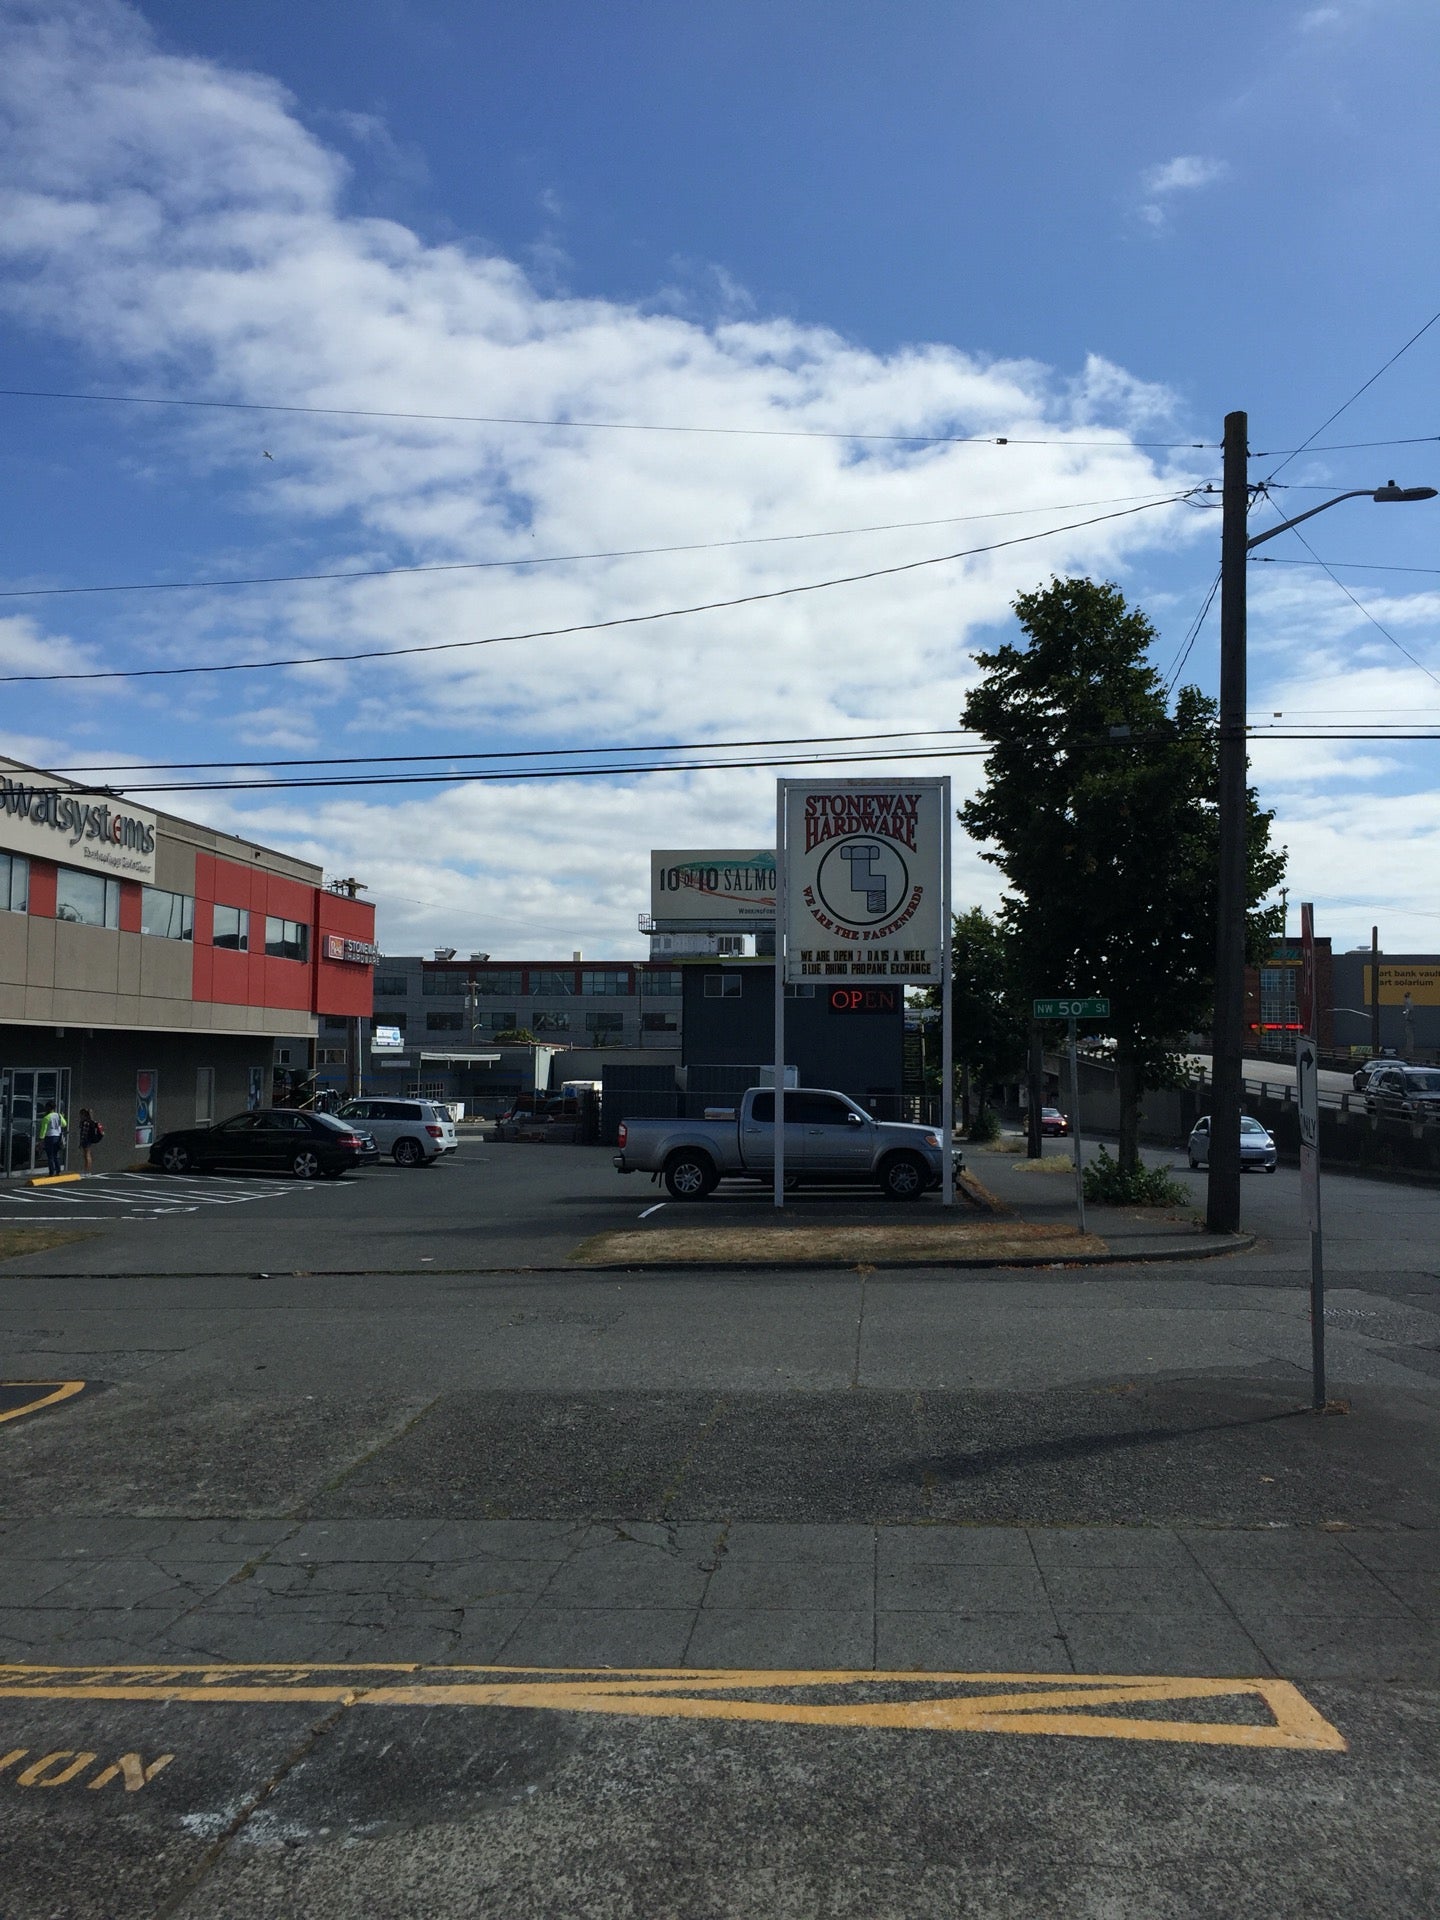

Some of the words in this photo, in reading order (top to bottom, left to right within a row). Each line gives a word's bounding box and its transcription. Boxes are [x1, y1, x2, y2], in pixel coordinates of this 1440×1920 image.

[805, 794, 922, 817] STONEWAY
[805, 815, 918, 855] HARDWARE
[660, 868, 680, 891] 10
[699, 867, 719, 891] 10
[724, 868, 777, 891] SALMO
[803, 885, 816, 907] WE
[811, 909, 833, 930] ARE
[834, 925, 860, 940] THE
[863, 885, 924, 940] FASTENERDS
[801, 950, 813, 962] WE
[816, 950, 830, 962] ARE
[833, 950, 853, 962] OPEN
[893, 950, 899, 962] A
[903, 950, 926, 962] WEEK
[802, 963, 821, 975] BLUE
[825, 963, 848, 975] RHINO
[851, 963, 887, 975] PROPANE
[890, 963, 931, 975] EXCHANGE
[831, 990, 895, 1009] OPEN
[1037, 1004, 1054, 1014] NW
[1095, 1003, 1107, 1014] St
